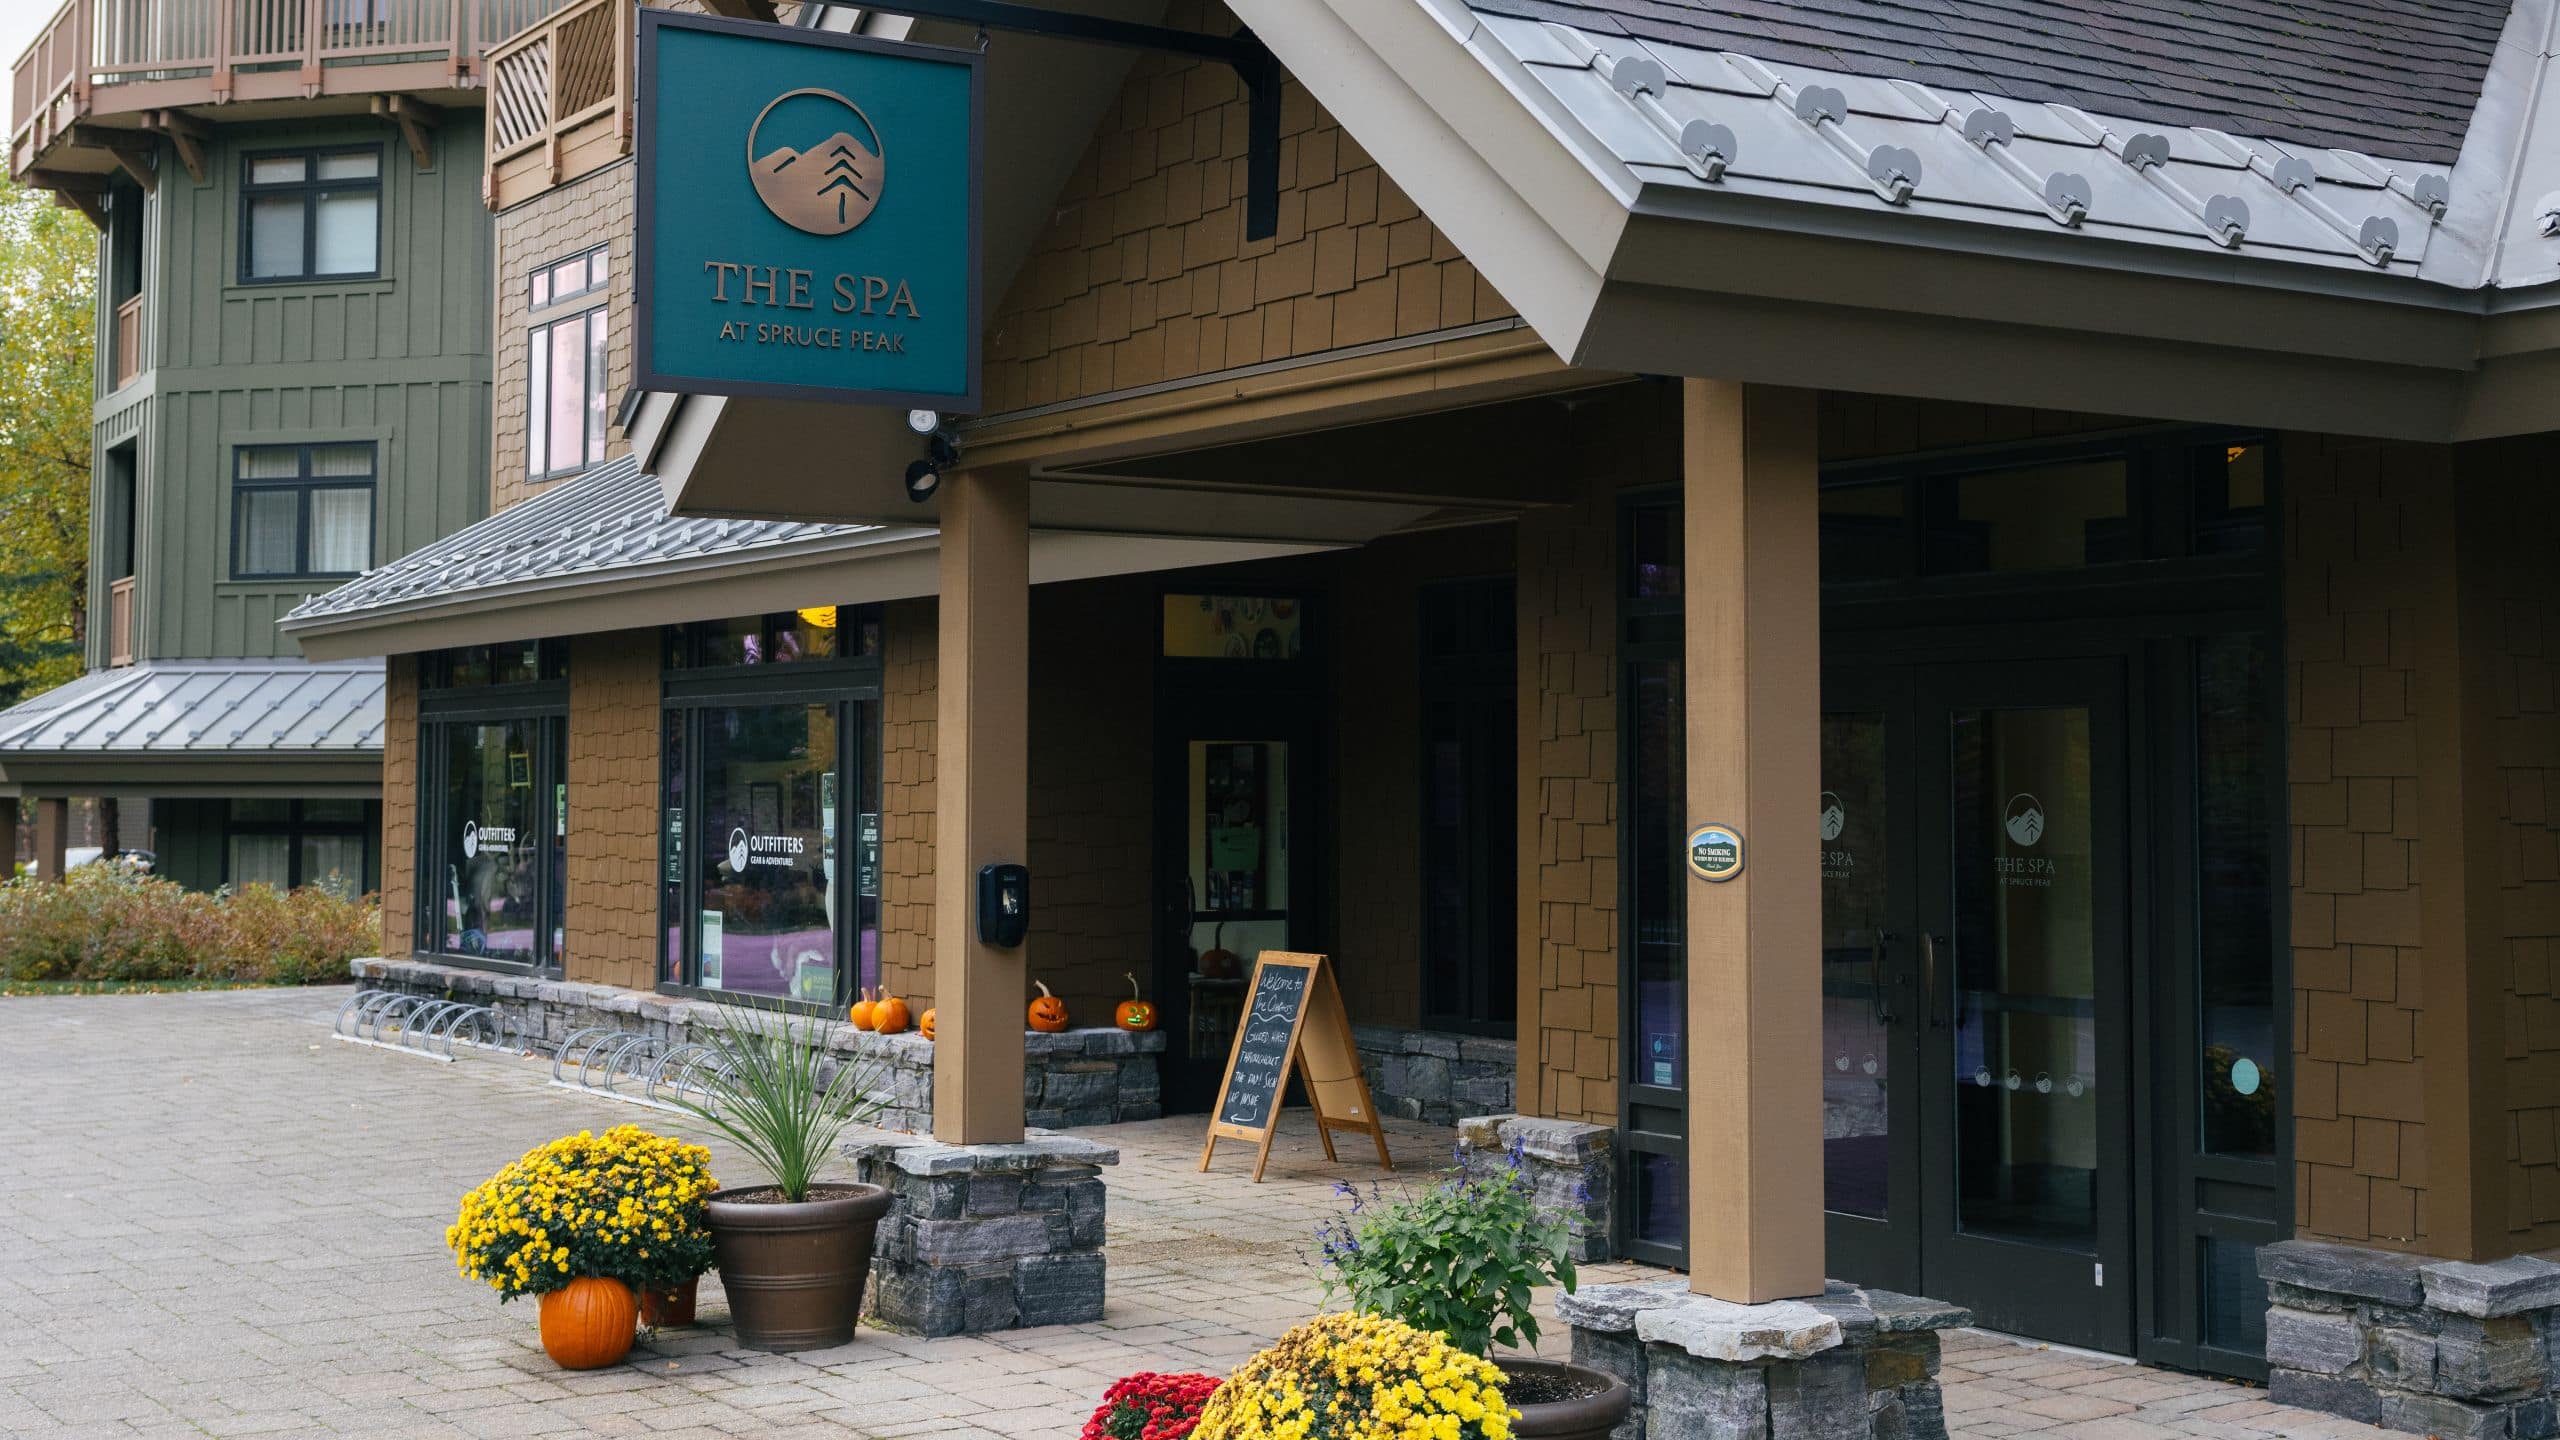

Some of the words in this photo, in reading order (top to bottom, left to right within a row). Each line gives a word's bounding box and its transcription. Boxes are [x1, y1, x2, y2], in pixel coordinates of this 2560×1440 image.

[704, 261, 814, 309] THE
[832, 273, 921, 318] SPA
[719, 320, 750, 341] AT
[757, 323, 841, 348] SPRUCE
[851, 330, 905, 352] PEAK
[478, 827, 516, 842] OUTFITTERS
[750, 835, 803, 854] OUTFITTERS
[1830, 851, 1854, 866] SPA
[1994, 857, 2025, 873] THE
[2028, 858, 2056, 874] SPA
